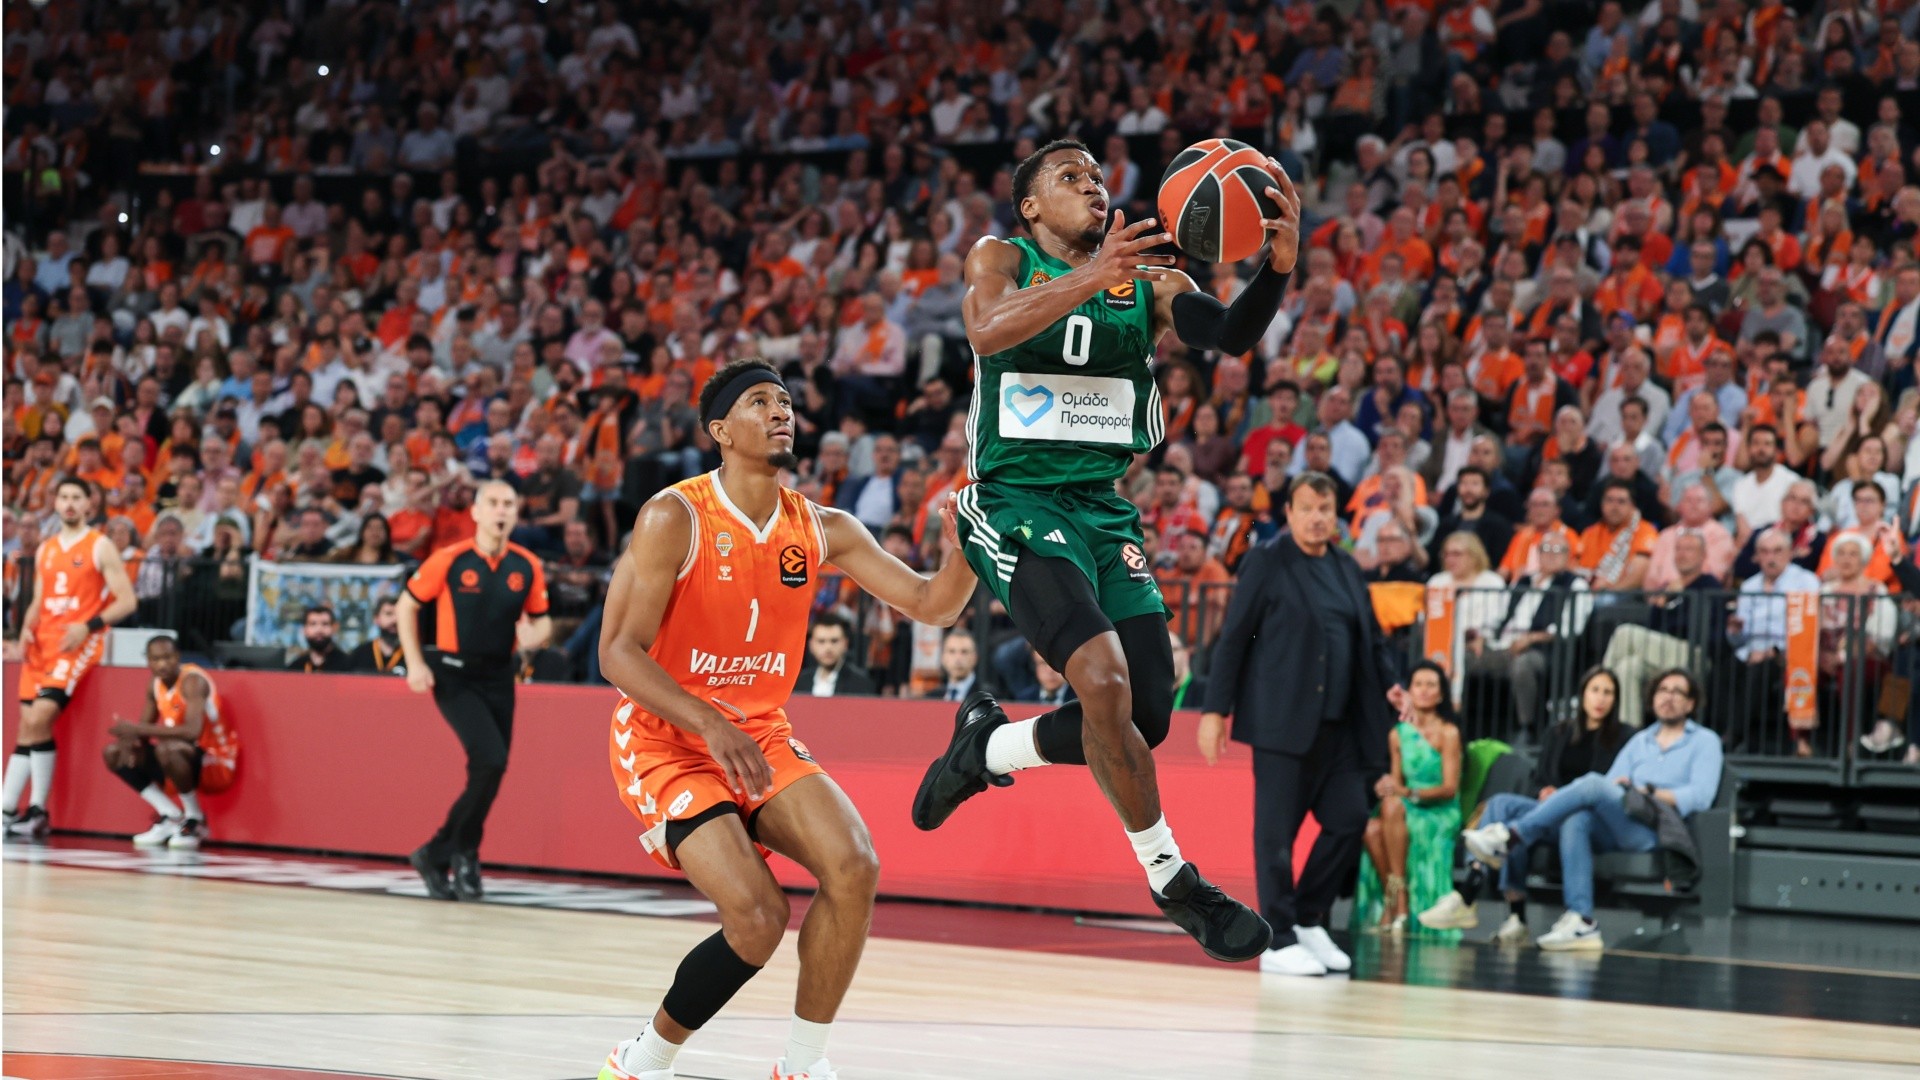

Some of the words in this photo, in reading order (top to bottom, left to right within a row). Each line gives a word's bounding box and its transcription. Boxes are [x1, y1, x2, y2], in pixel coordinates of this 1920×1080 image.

[1062, 314, 1093, 367] 0
[1061, 391, 1109, 409] Ομάδα
[1060, 410, 1132, 430] Προσφοράς
[54, 570, 69, 595] 2
[744, 598, 760, 643] 1
[51, 658, 71, 681] 2
[689, 648, 786, 677] VALENCIA
[706, 673, 757, 687] BASKET
